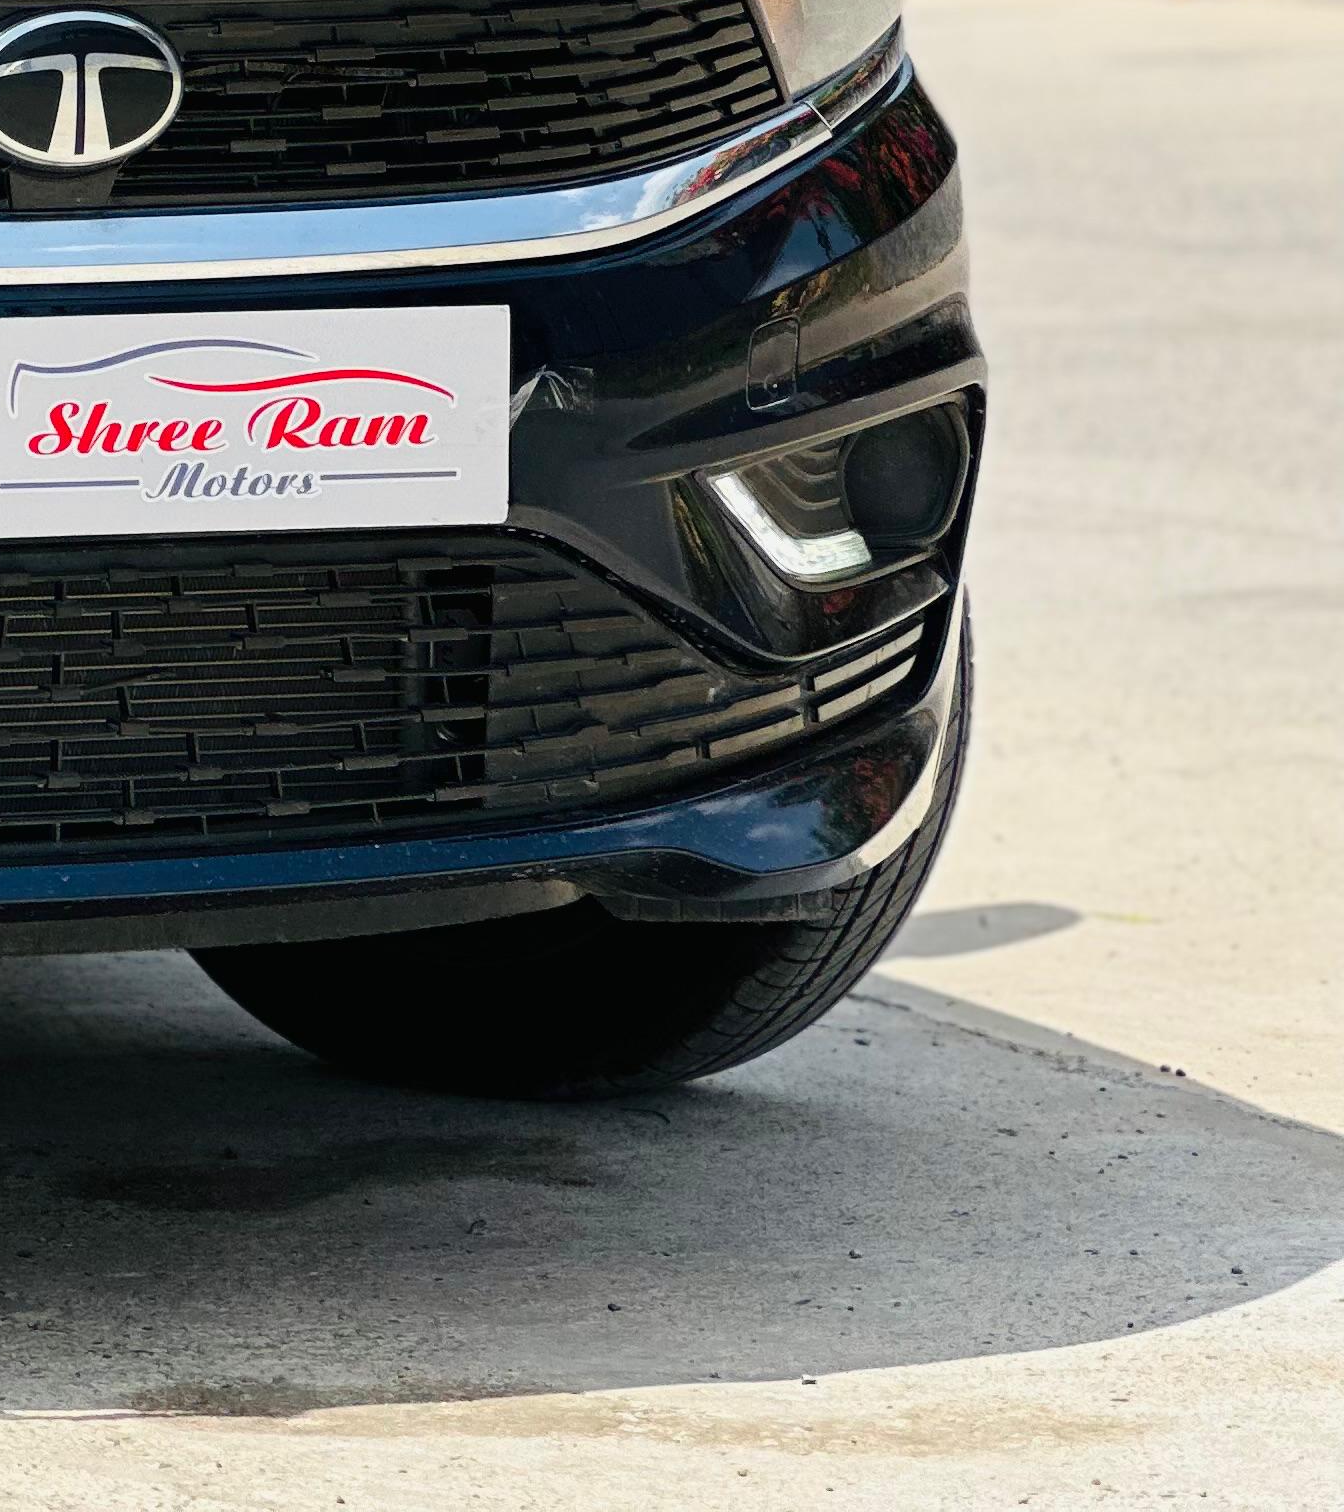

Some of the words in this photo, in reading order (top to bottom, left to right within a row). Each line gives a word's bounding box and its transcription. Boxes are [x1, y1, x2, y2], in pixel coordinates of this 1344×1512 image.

[29, 401, 226, 455] Shree
[247, 396, 435, 450] Ram
[144, 462, 316, 500] Motors
